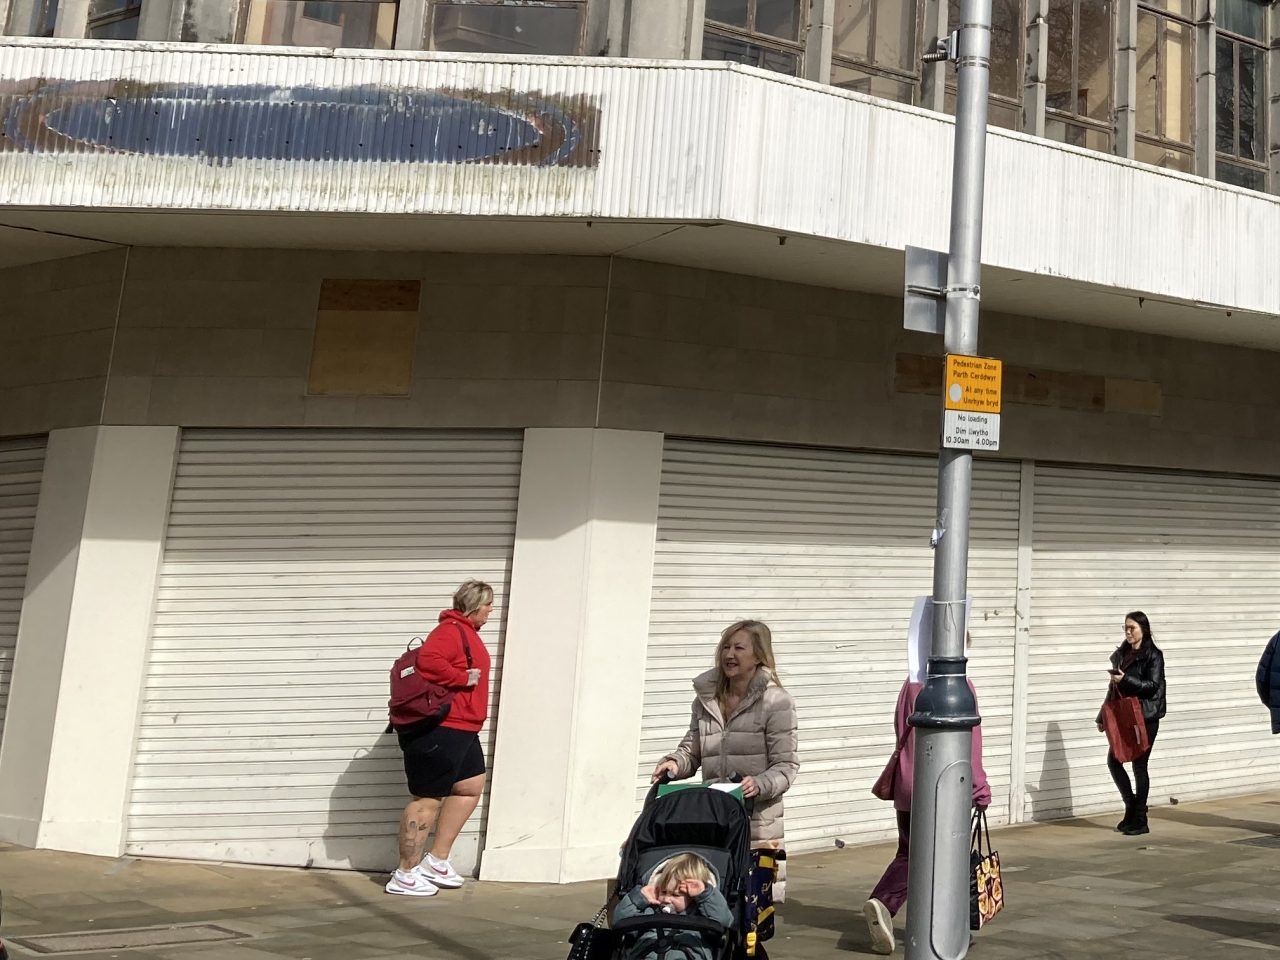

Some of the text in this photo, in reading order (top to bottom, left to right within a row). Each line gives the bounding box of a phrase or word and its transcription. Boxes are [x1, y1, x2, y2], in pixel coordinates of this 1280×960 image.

[953, 359, 996, 371] Pedestrian Zone
[953, 370, 996, 382] Parth Cerddwyr
[986, 387, 997, 395] time
[963, 397, 999, 407] Unrhyw bryd
[957, 414, 988, 424] No loading
[955, 427, 967, 435] Dim
[945, 436, 998, 446] 10.30am 4.00pm
